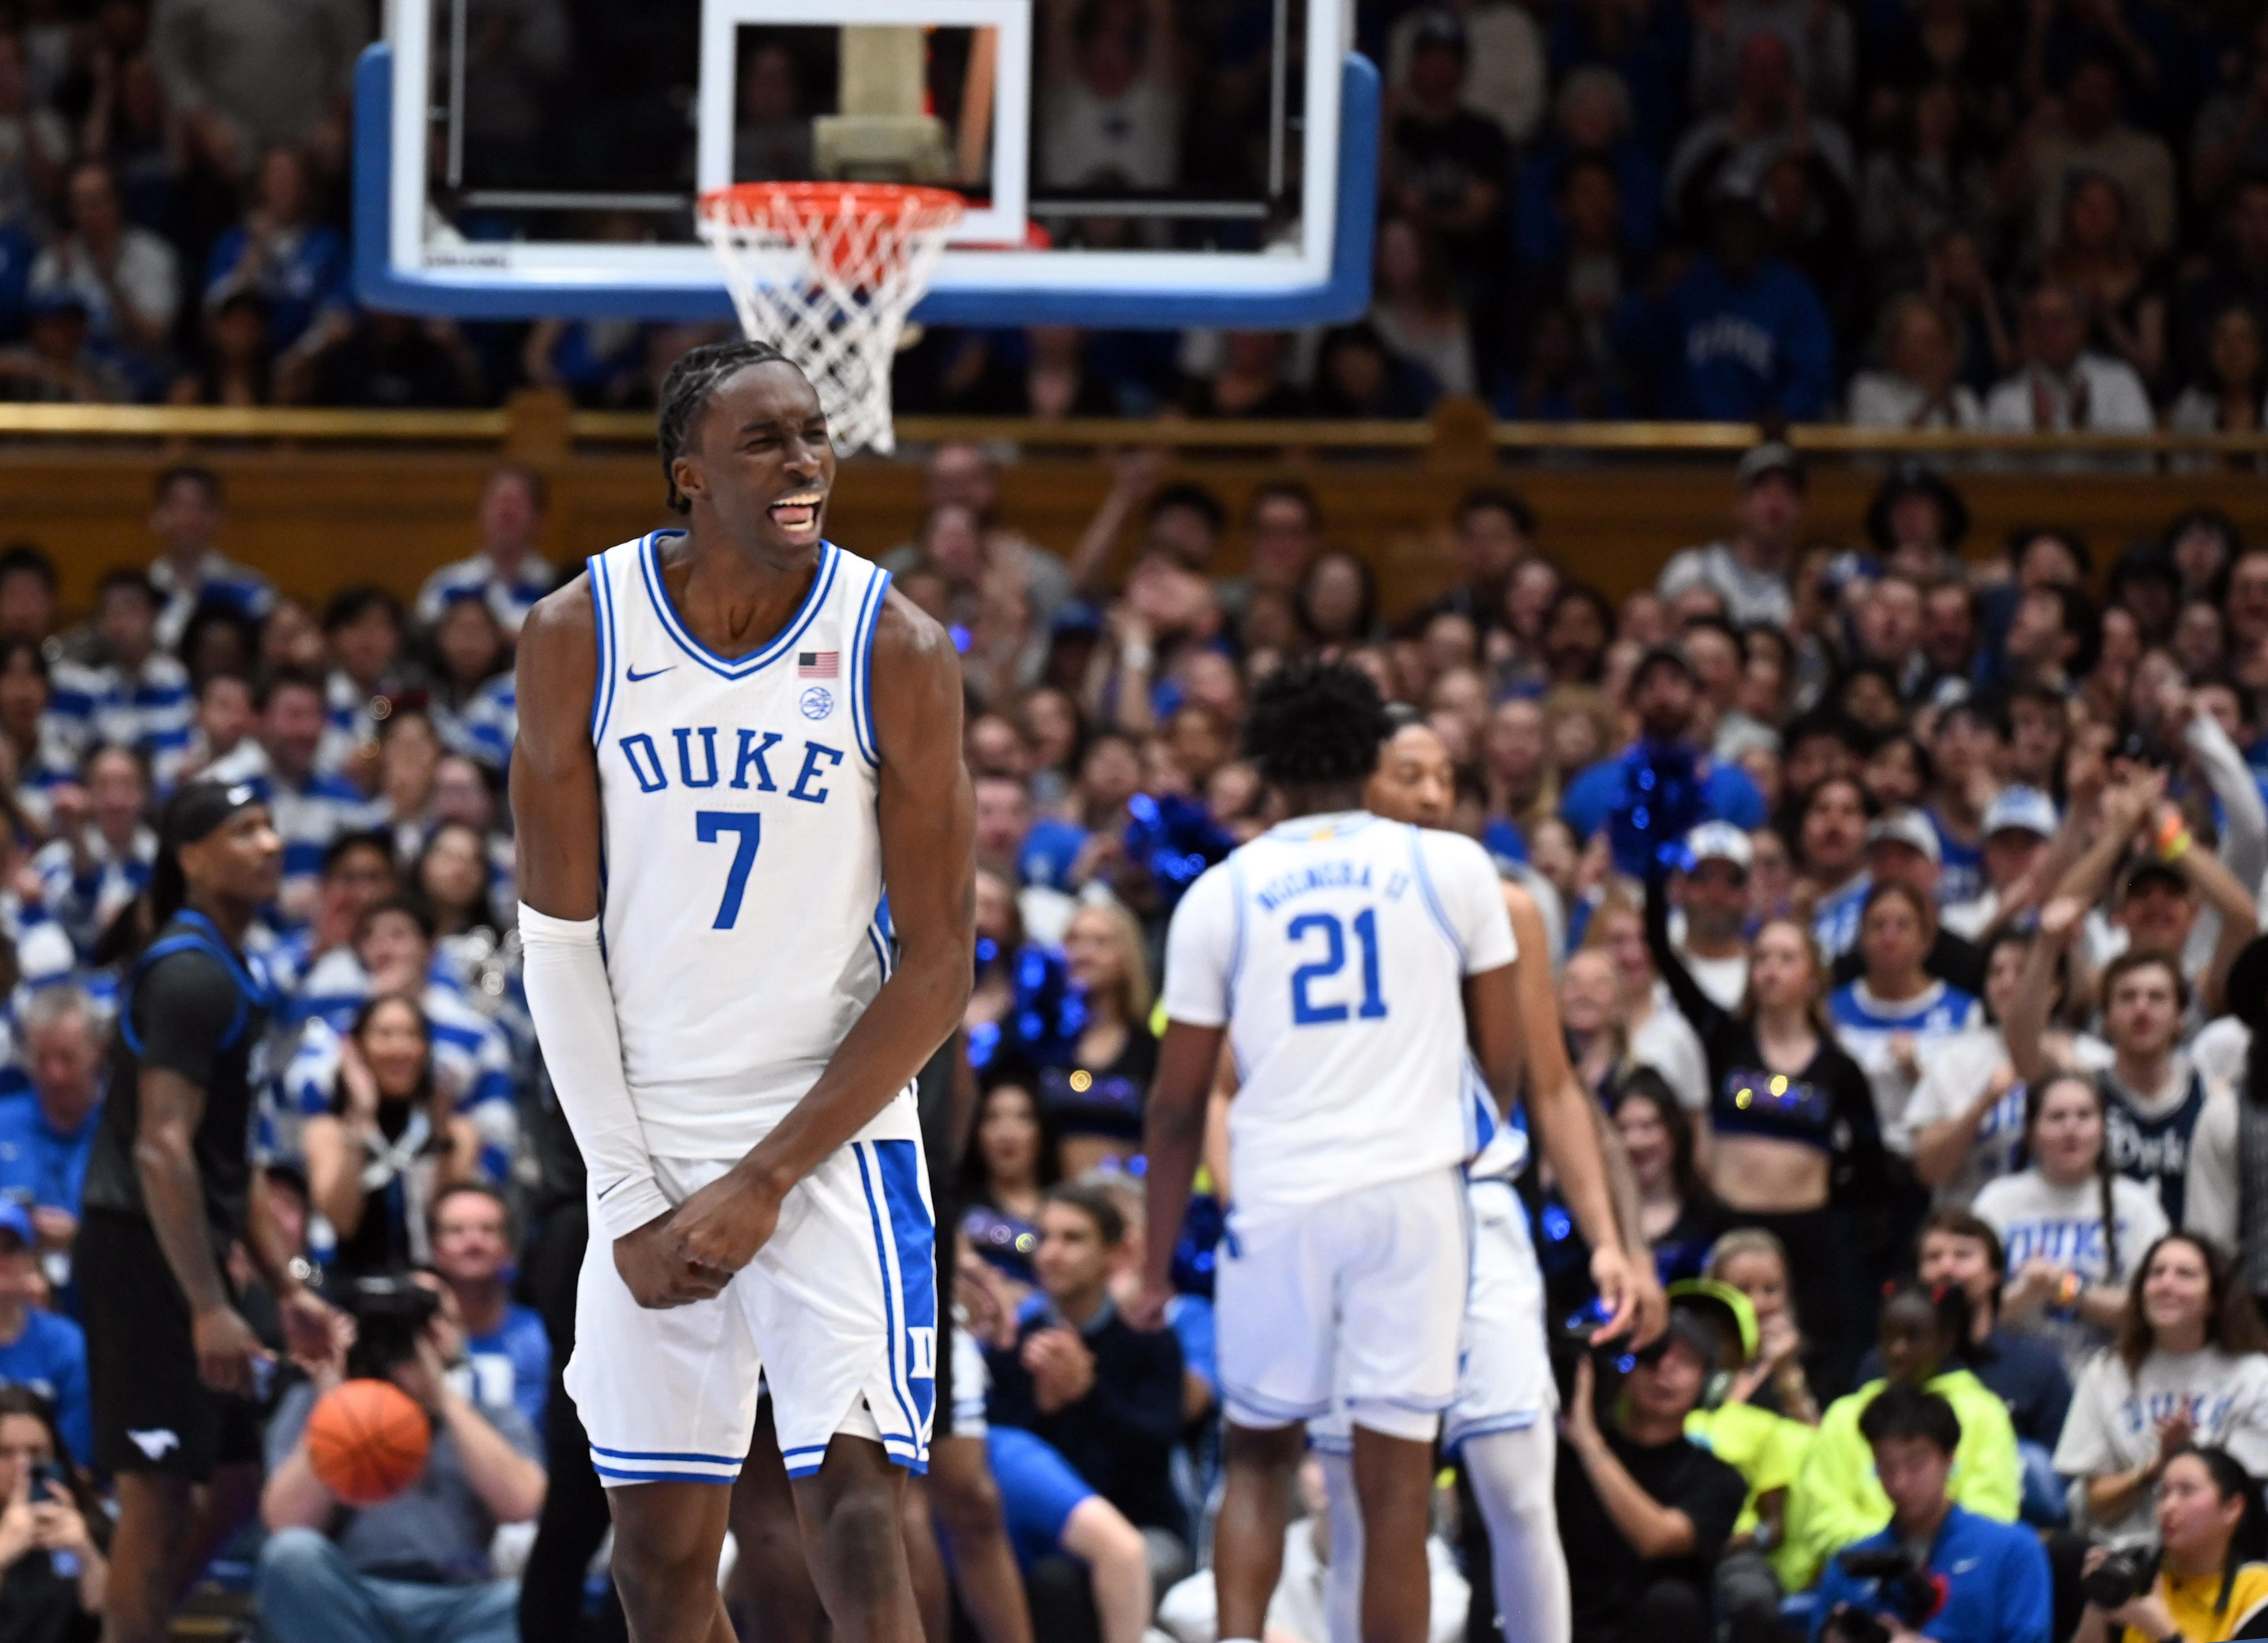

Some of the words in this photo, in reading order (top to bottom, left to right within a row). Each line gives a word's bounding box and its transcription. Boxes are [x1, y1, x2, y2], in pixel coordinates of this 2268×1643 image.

[619, 727, 844, 803] DUKE
[696, 811, 760, 930] 7
[1287, 906, 1388, 1025] 21
[2106, 1105, 2186, 1173] Duk
